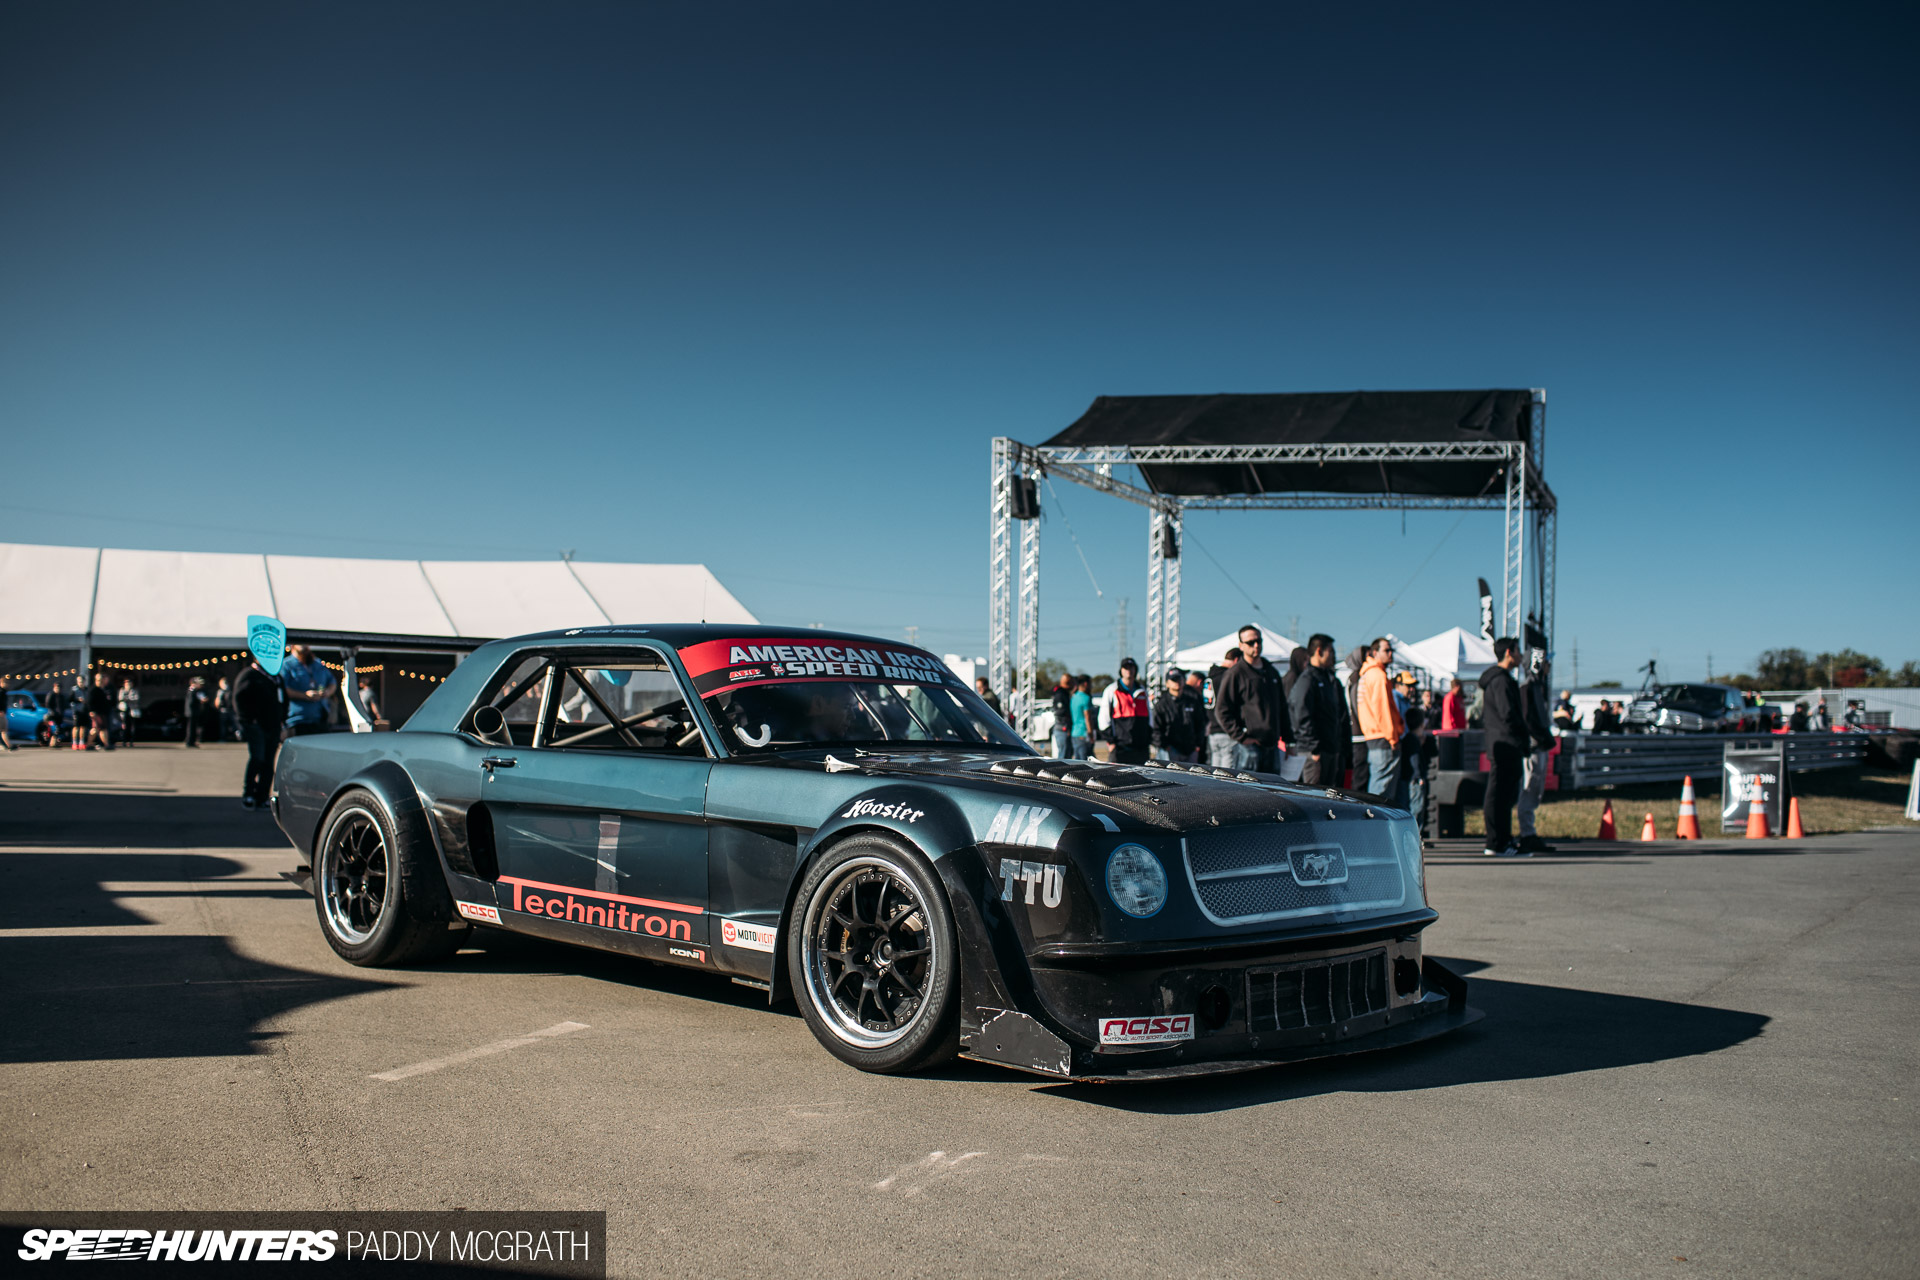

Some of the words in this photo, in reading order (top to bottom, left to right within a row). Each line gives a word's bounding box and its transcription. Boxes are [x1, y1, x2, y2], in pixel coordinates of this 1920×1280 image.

[729, 645, 883, 665] AMERICAN
[885, 650, 949, 674] IRON
[785, 661, 878, 677] SPEED
[881, 665, 942, 684] RING
[841, 798, 925, 824] Hoosier
[1000, 858, 1067, 908] TTU
[497, 875, 704, 941] Technitron
[669, 947, 701, 960] KONI
[1103, 1016, 1191, 1037] nasa
